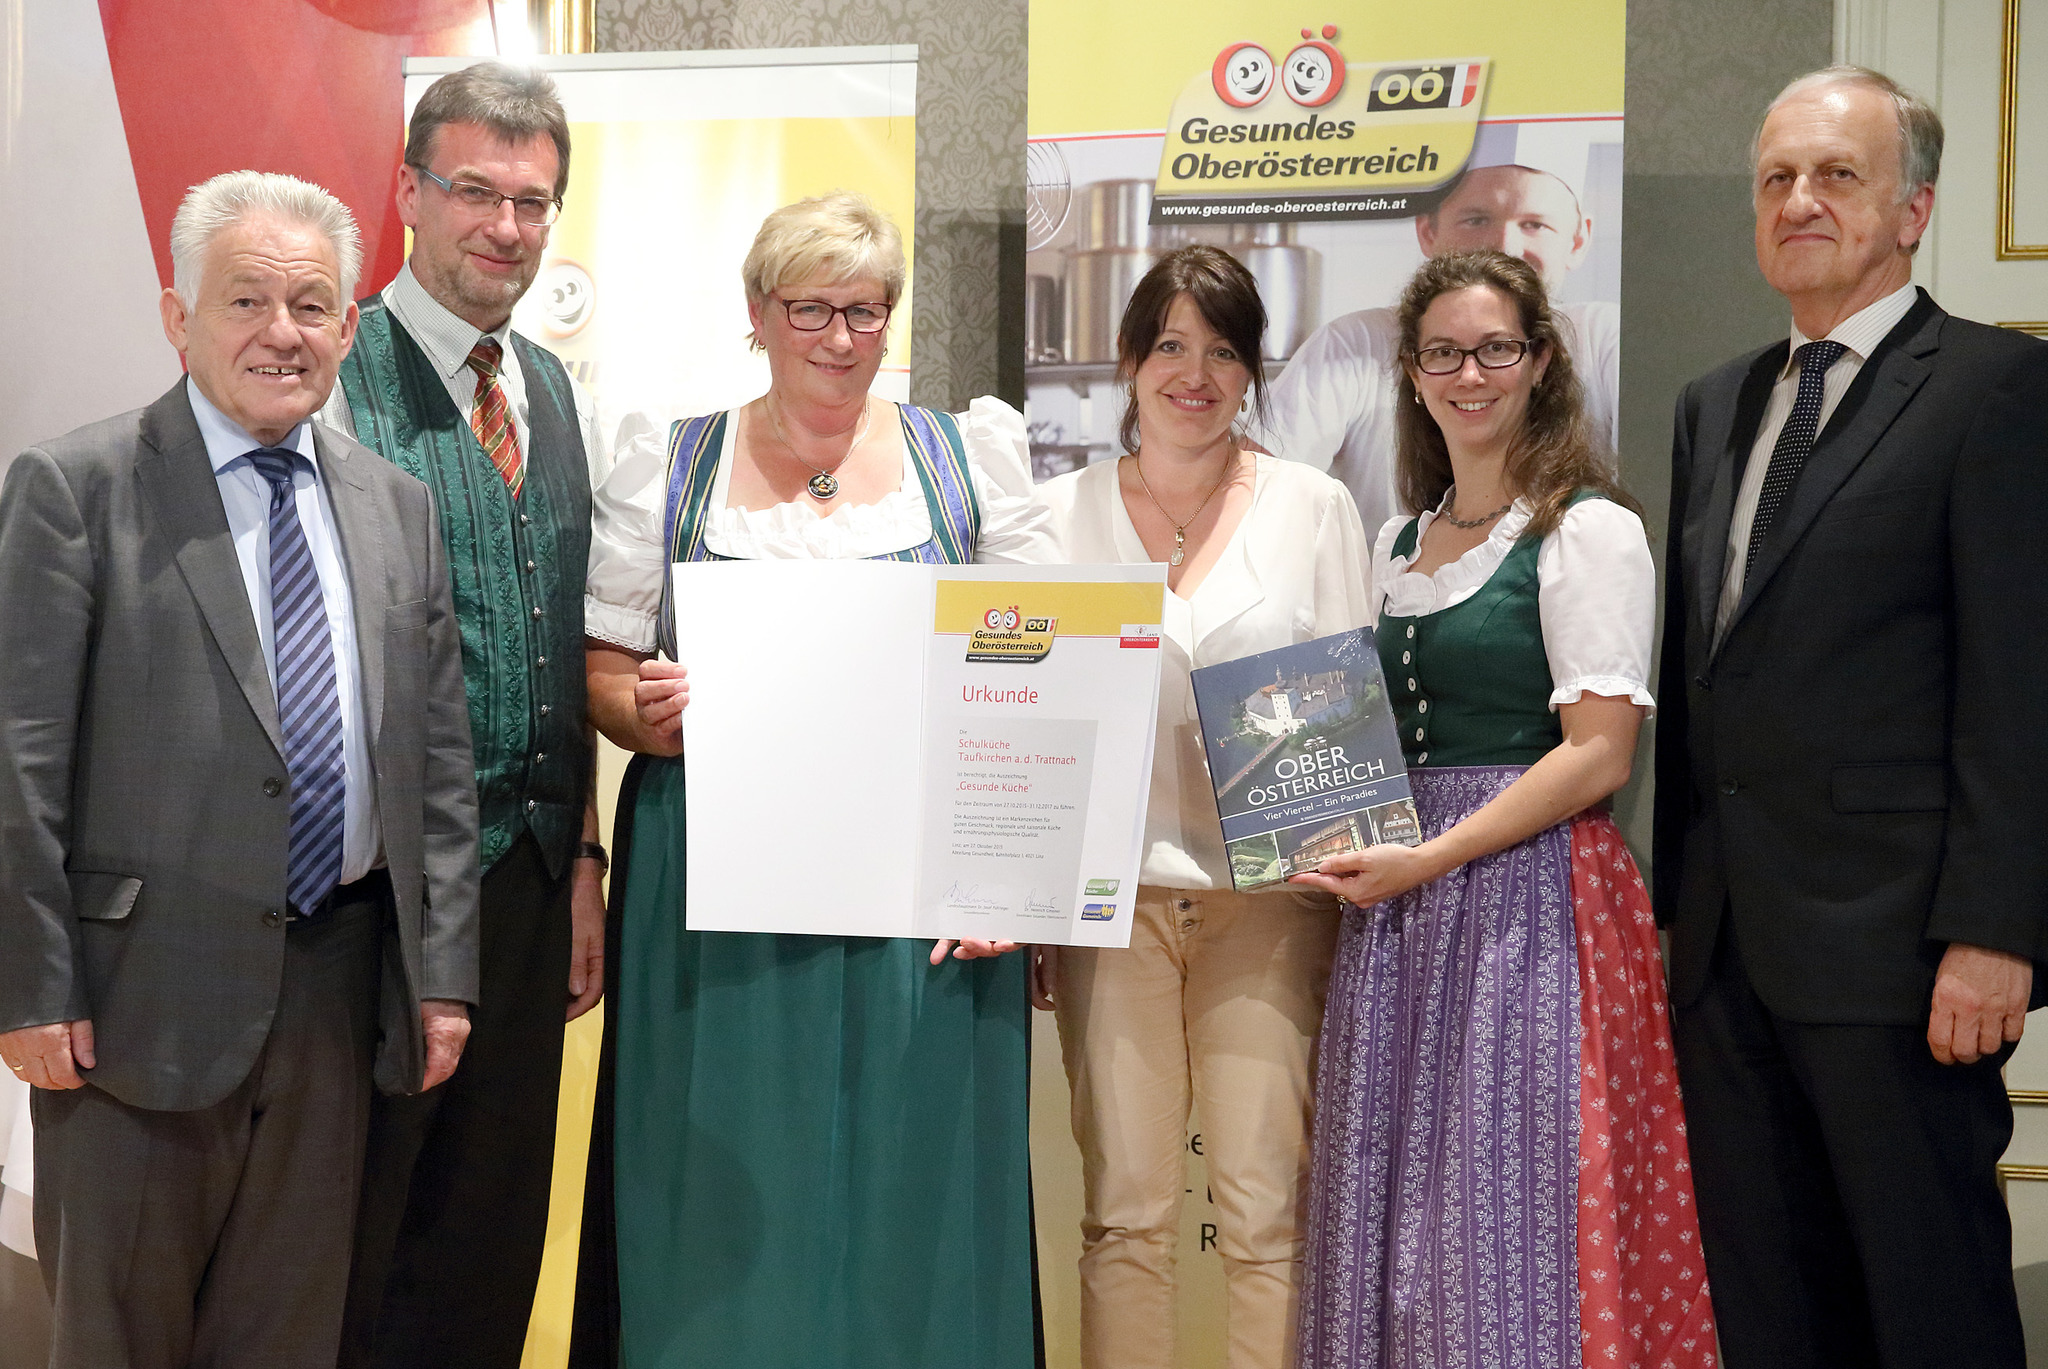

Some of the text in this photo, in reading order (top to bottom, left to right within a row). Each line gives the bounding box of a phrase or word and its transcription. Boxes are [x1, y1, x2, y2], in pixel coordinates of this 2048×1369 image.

[1377, 66, 1445, 105] OÖ
[1181, 114, 1355, 144] Gesundes
[1171, 145, 1439, 180] Oberösterreich
[1161, 198, 1407, 217] www.gesundes-oberoesterreich.at
[972, 641, 1044, 651] Oberösterreich
[975, 630, 1022, 640] Gesundes
[962, 685, 1039, 704] Urkunde
[958, 738, 1011, 750] Schulküche
[958, 751, 1012, 763] Taufkirchen
[1034, 754, 1077, 765] Trattnach
[1274, 746, 1351, 780] OBER
[1247, 758, 1386, 806] ÖSTERREICH
[1263, 812, 1283, 821] Vier
[1282, 802, 1314, 817] Viertel
[1324, 798, 1339, 807] Ein
[1340, 789, 1378, 803] Paradies
